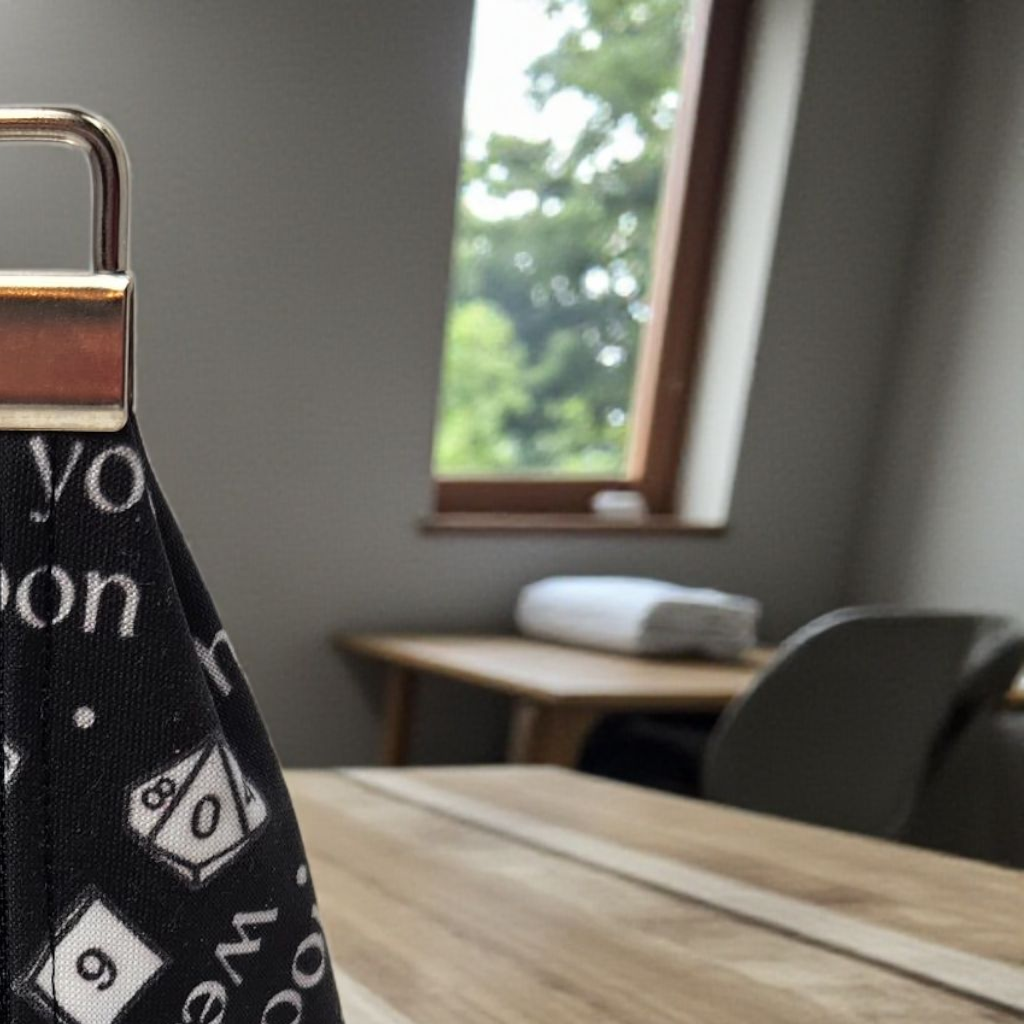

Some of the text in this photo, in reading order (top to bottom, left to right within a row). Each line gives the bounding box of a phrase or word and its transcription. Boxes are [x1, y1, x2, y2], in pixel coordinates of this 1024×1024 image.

[29, 435, 144, 523] yo
[141, 778, 175, 810] 8
[192, 794, 220, 839] 0
